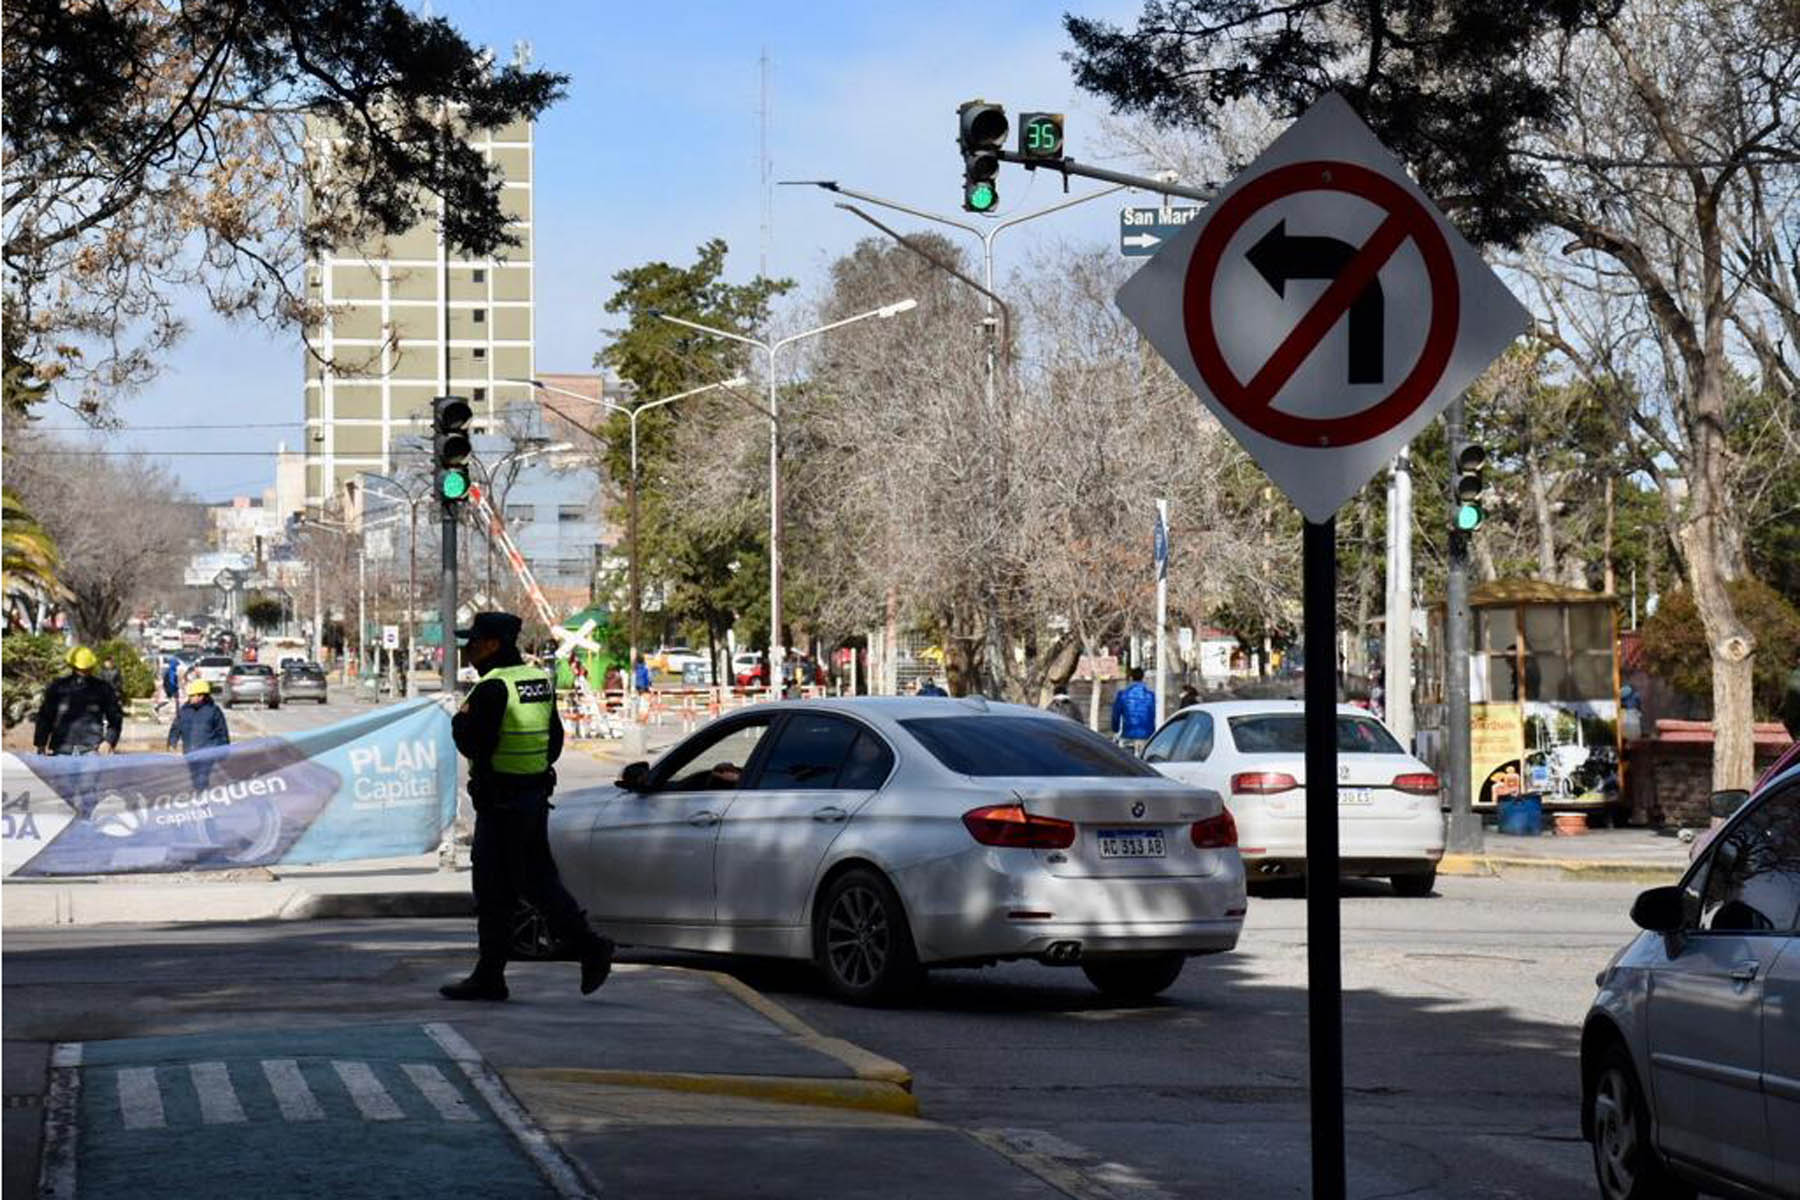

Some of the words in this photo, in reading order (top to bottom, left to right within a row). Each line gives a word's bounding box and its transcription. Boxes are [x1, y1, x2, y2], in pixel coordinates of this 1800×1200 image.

[1029, 123, 1054, 148] 35
[1124, 207, 1153, 225] San
[1158, 206, 1199, 225] Mart
[349, 739, 437, 775] PLAN
[355, 771, 438, 803] Capital
[156, 807, 213, 827] capital
